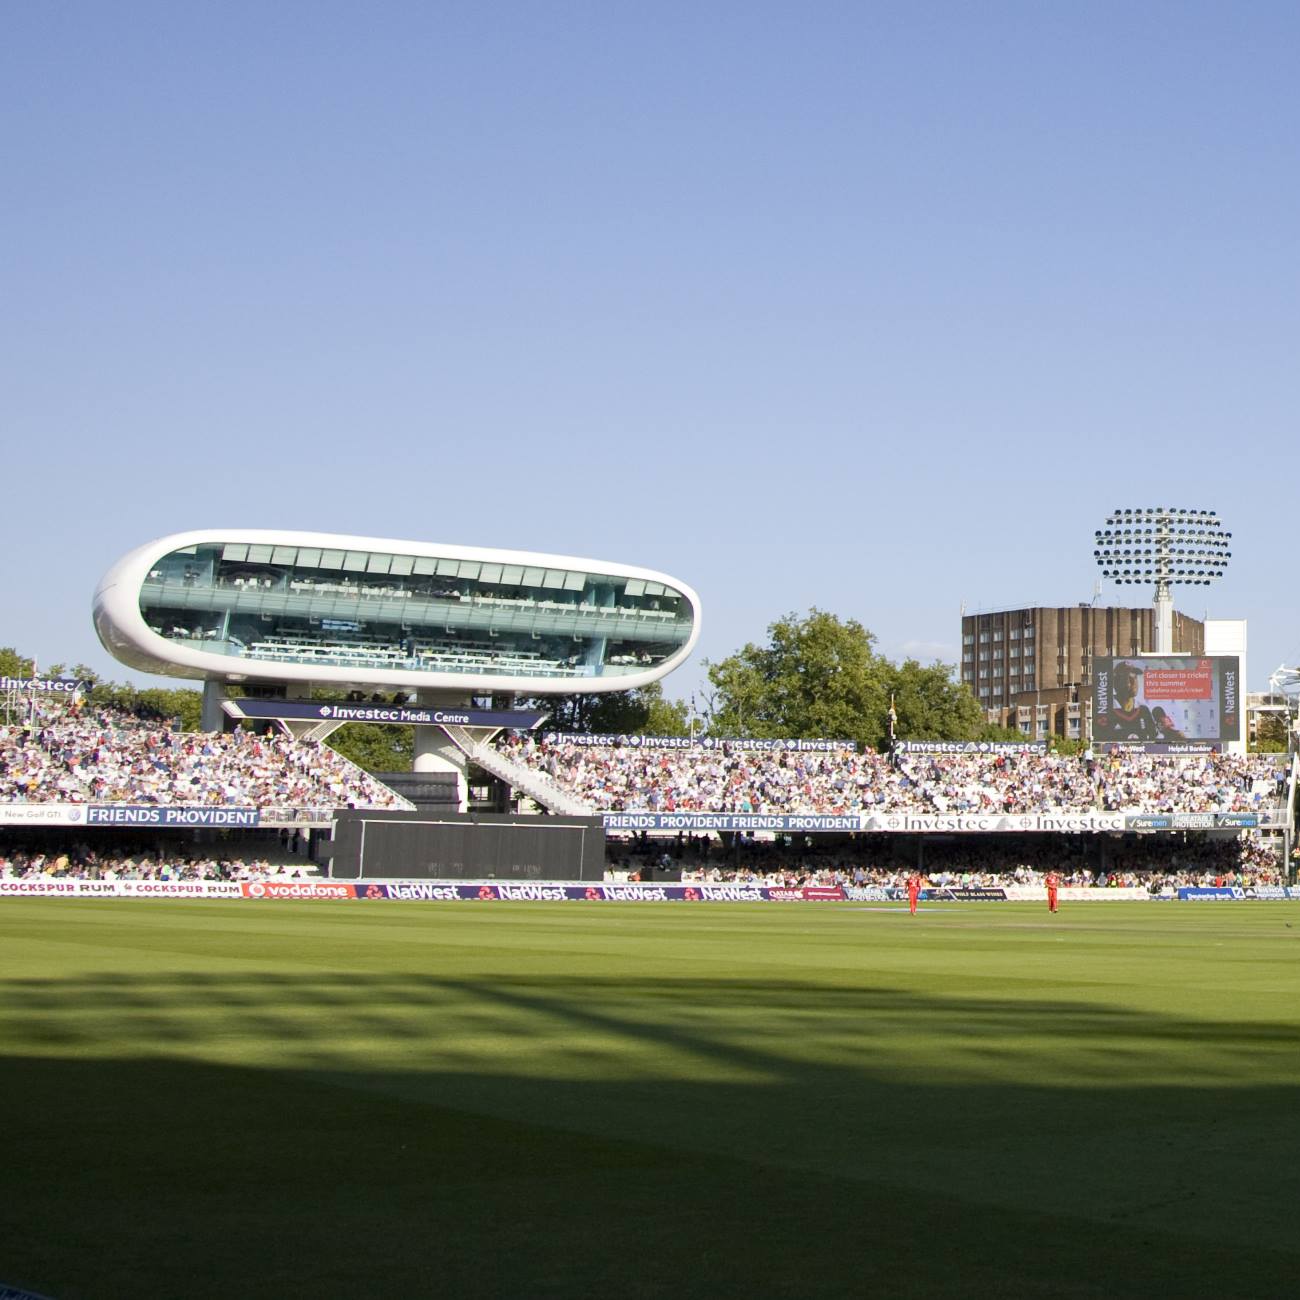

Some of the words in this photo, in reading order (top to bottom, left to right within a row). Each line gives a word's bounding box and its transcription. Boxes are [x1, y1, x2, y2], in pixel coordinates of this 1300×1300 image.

[0, 675, 74, 691] Investec
[1097, 672, 1108, 714] NatWest
[1224, 672, 1235, 714] NatWest
[332, 706, 399, 720] Investec
[401, 710, 430, 722] Media
[434, 711, 470, 723] Centre
[557, 732, 614, 745] Investec
[641, 735, 698, 747] Investec
[907, 741, 963, 752] Investec
[1168, 745, 1189, 753] Helpful
[28, 810, 45, 819] Golf
[89, 809, 160, 822] FRIENDS
[166, 810, 258, 824] PROVIDENT
[602, 816, 655, 827] FRIENDS
[661, 816, 729, 827] PROVIDENT
[732, 817, 784, 828] FRIENDS
[789, 817, 859, 828] PROVIDENT
[904, 816, 989, 830] Investec
[1036, 816, 1121, 829] Investec
[0, 883, 75, 892] COCKSPUR
[80, 884, 115, 892] RUM
[136, 884, 203, 893] COCKSPUR
[207, 885, 240, 893] RUM
[268, 886, 348, 897] vodafone
[387, 884, 460, 899] NatWest
[497, 886, 568, 900] NatWest
[602, 886, 667, 900] NatWest
[701, 887, 764, 900] NatWest
